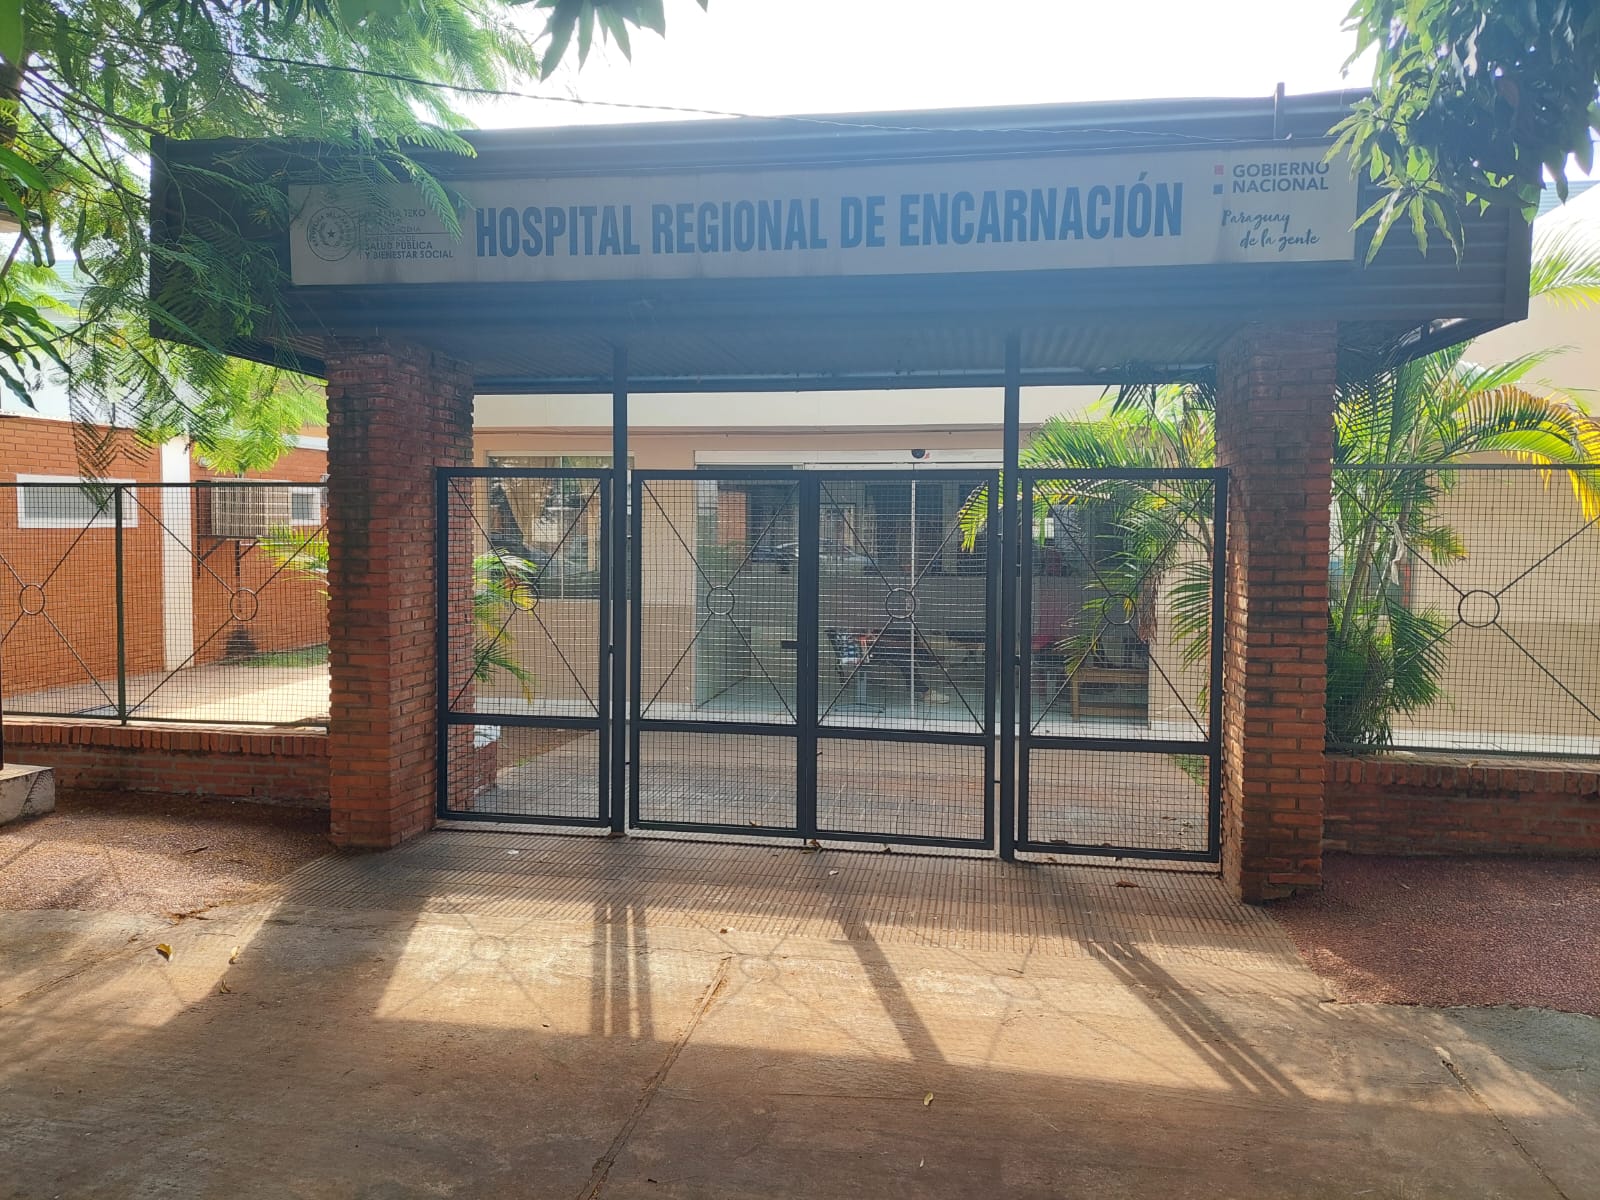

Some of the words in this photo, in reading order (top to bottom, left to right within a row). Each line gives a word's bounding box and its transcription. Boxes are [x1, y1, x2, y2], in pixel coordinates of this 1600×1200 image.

[1232, 161, 1330, 178] GOBIERNO
[1232, 177, 1329, 194] NACIONAL
[476, 204, 640, 258] HOSPITAL
[652, 198, 828, 254] REGIONAL
[841, 195, 886, 248] DE
[900, 171, 1183, 247] ENCARNACIÓN
[1221, 208, 1291, 233] Paraguay
[1239, 230, 1257, 248] de
[1260, 229, 1275, 247] la
[1277, 229, 1320, 252] gente
[373, 250, 418, 260] BIENESTAR
[419, 249, 454, 259] SOCIAL
